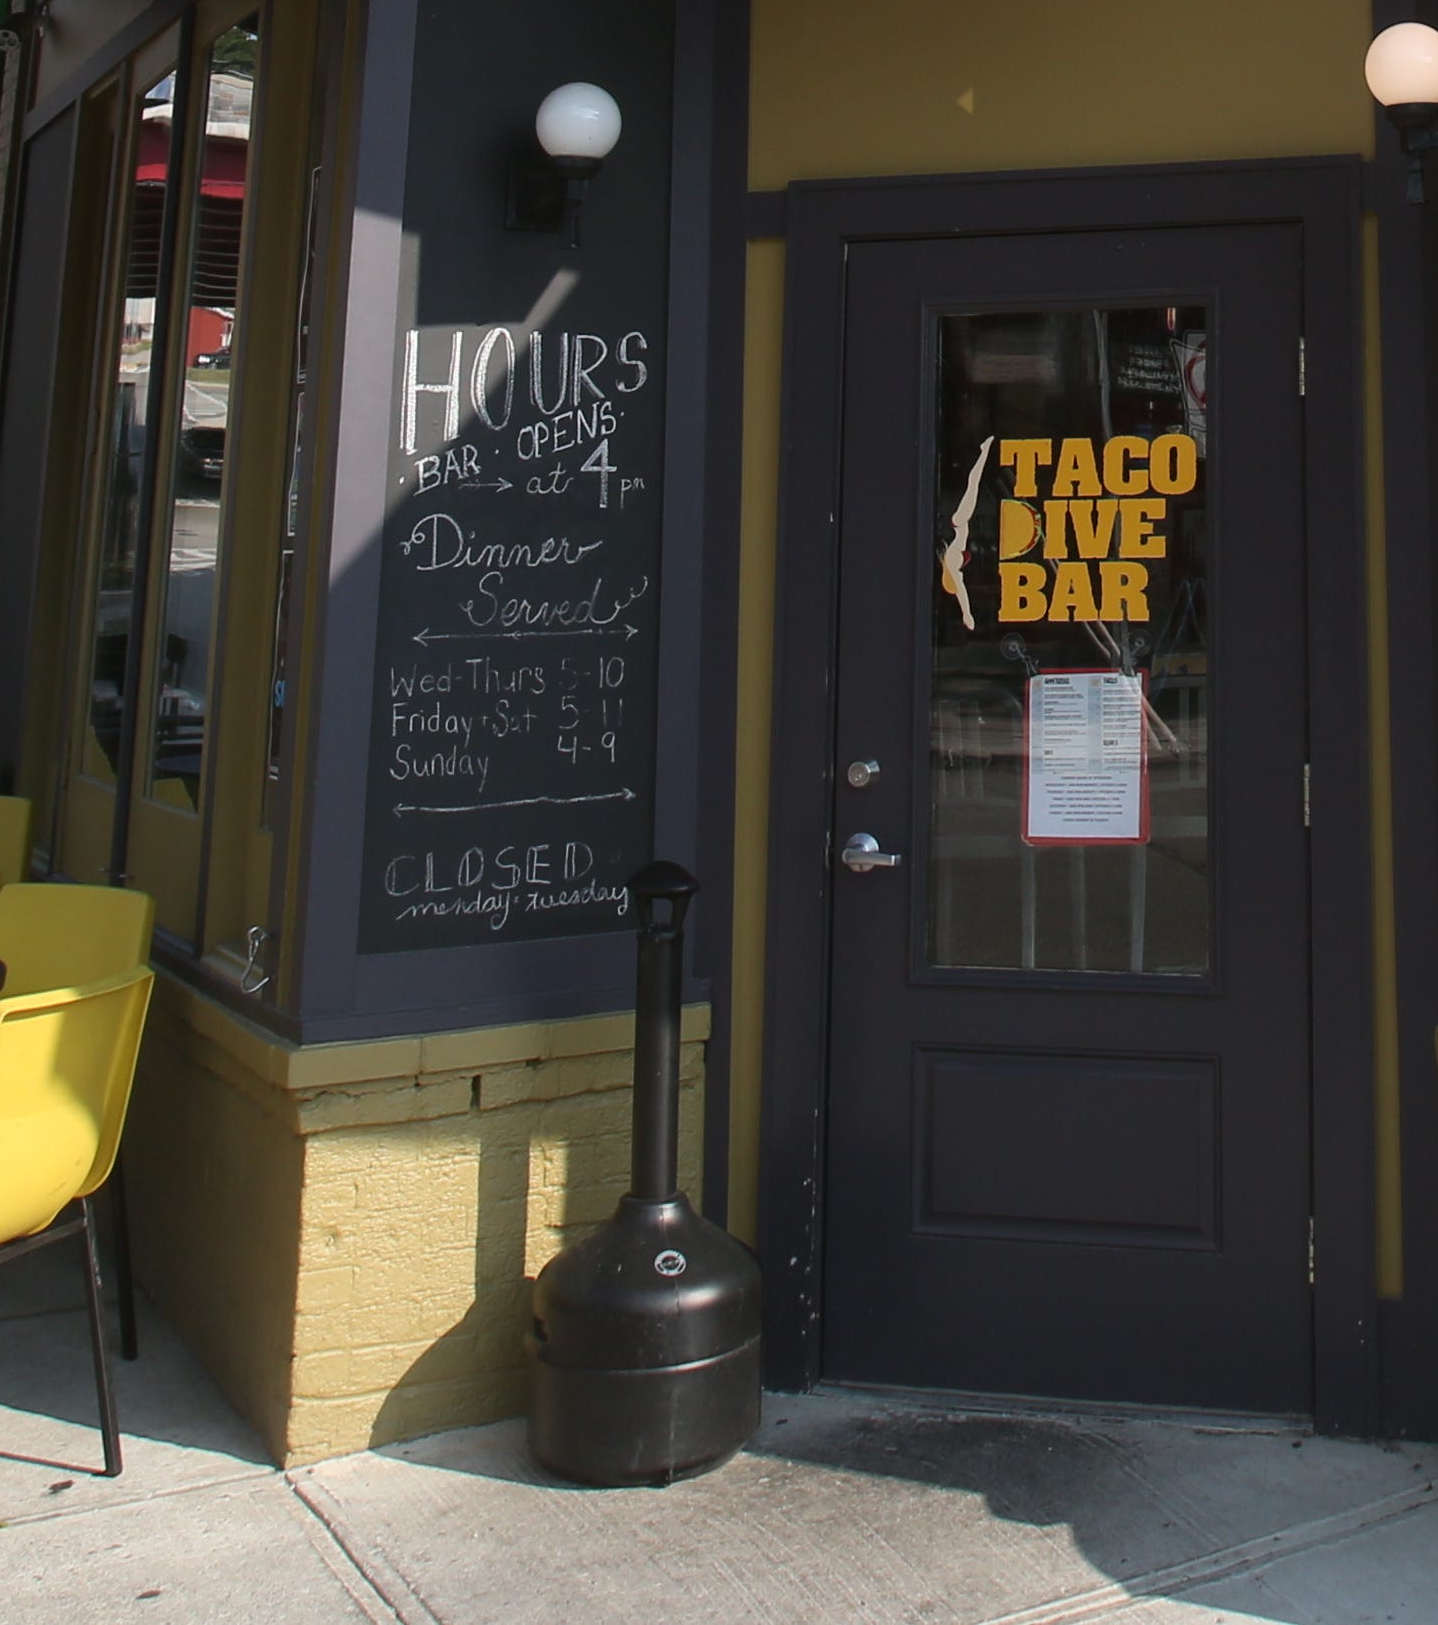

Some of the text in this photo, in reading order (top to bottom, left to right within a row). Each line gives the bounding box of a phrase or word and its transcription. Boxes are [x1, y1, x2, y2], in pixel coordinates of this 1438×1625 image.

[399, 327, 649, 455] HOURS
[413, 401, 617, 496] BAR OPENS
[526, 462, 575, 494] at
[580, 438, 617, 509] 4
[1000, 434, 1197, 497] TACO
[399, 513, 604, 570] Dinner
[999, 498, 1167, 561] DIVE
[458, 572, 649, 627] Served
[998, 561, 1150, 622] BAR
[392, 701, 473, 748] Friday
[389, 743, 490, 794] Sunday
[385, 841, 594, 897] CLOSED
